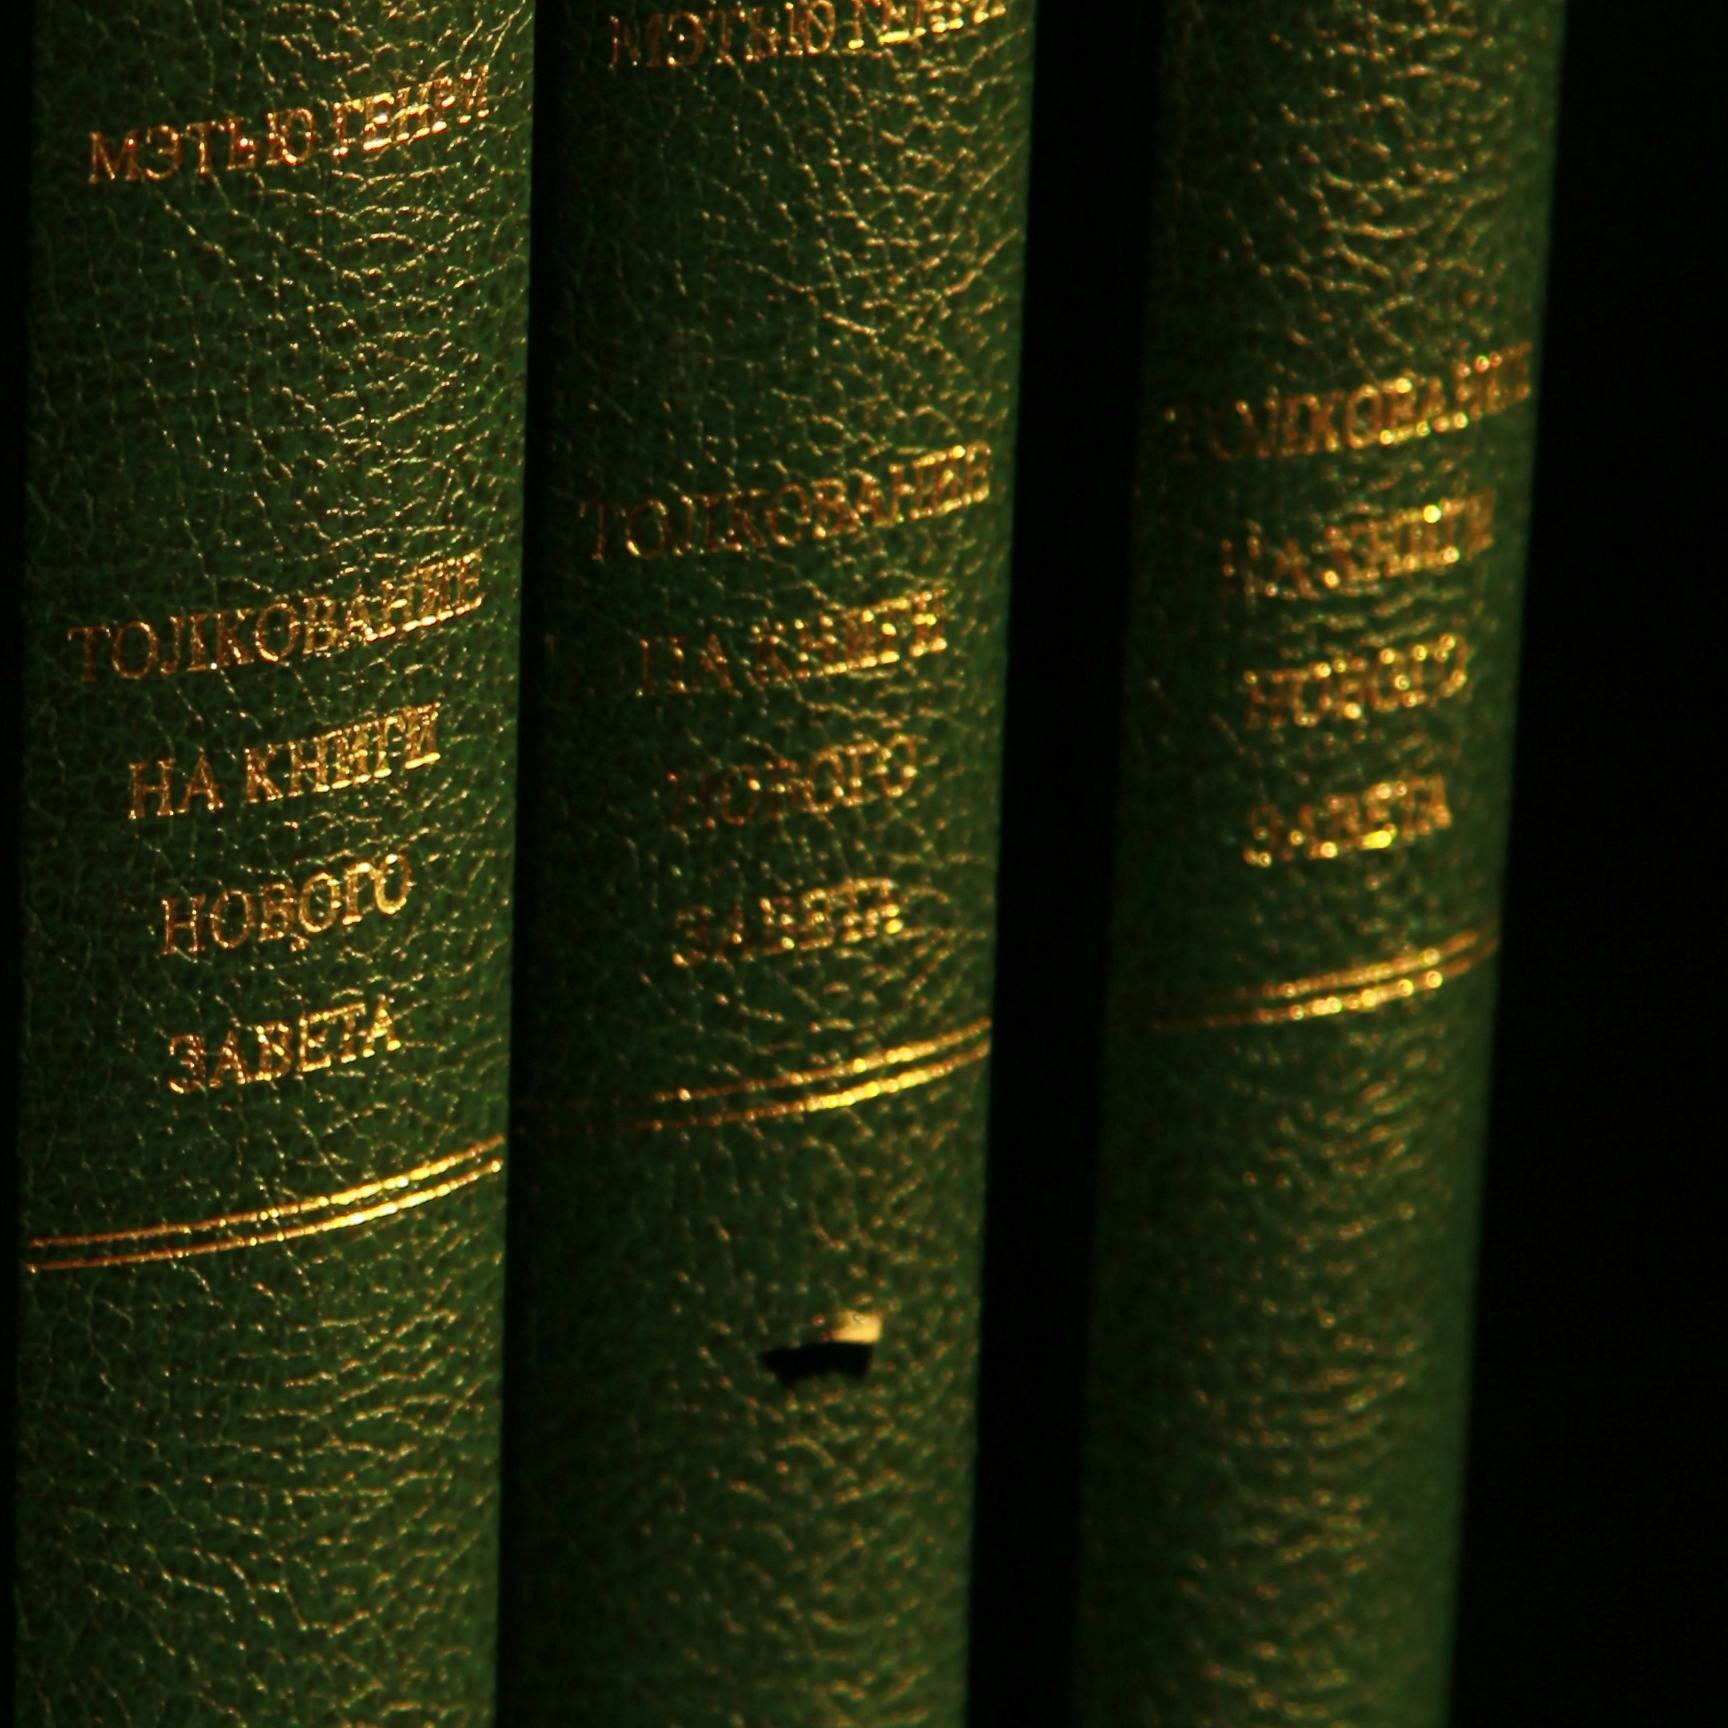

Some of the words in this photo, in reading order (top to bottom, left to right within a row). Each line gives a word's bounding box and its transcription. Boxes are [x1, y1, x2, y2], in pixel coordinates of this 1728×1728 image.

[86, 107, 316, 185] МЭТЬЮ
[330, 65, 491, 158] ГЕНРИ
[65, 549, 484, 683] ТОЛКОВАНИЕ
[127, 747, 225, 821] НА
[239, 702, 442, 805] КНИГИ
[159, 853, 413, 956] НОВОГО
[167, 994, 403, 1095] ЗАВЕТА
